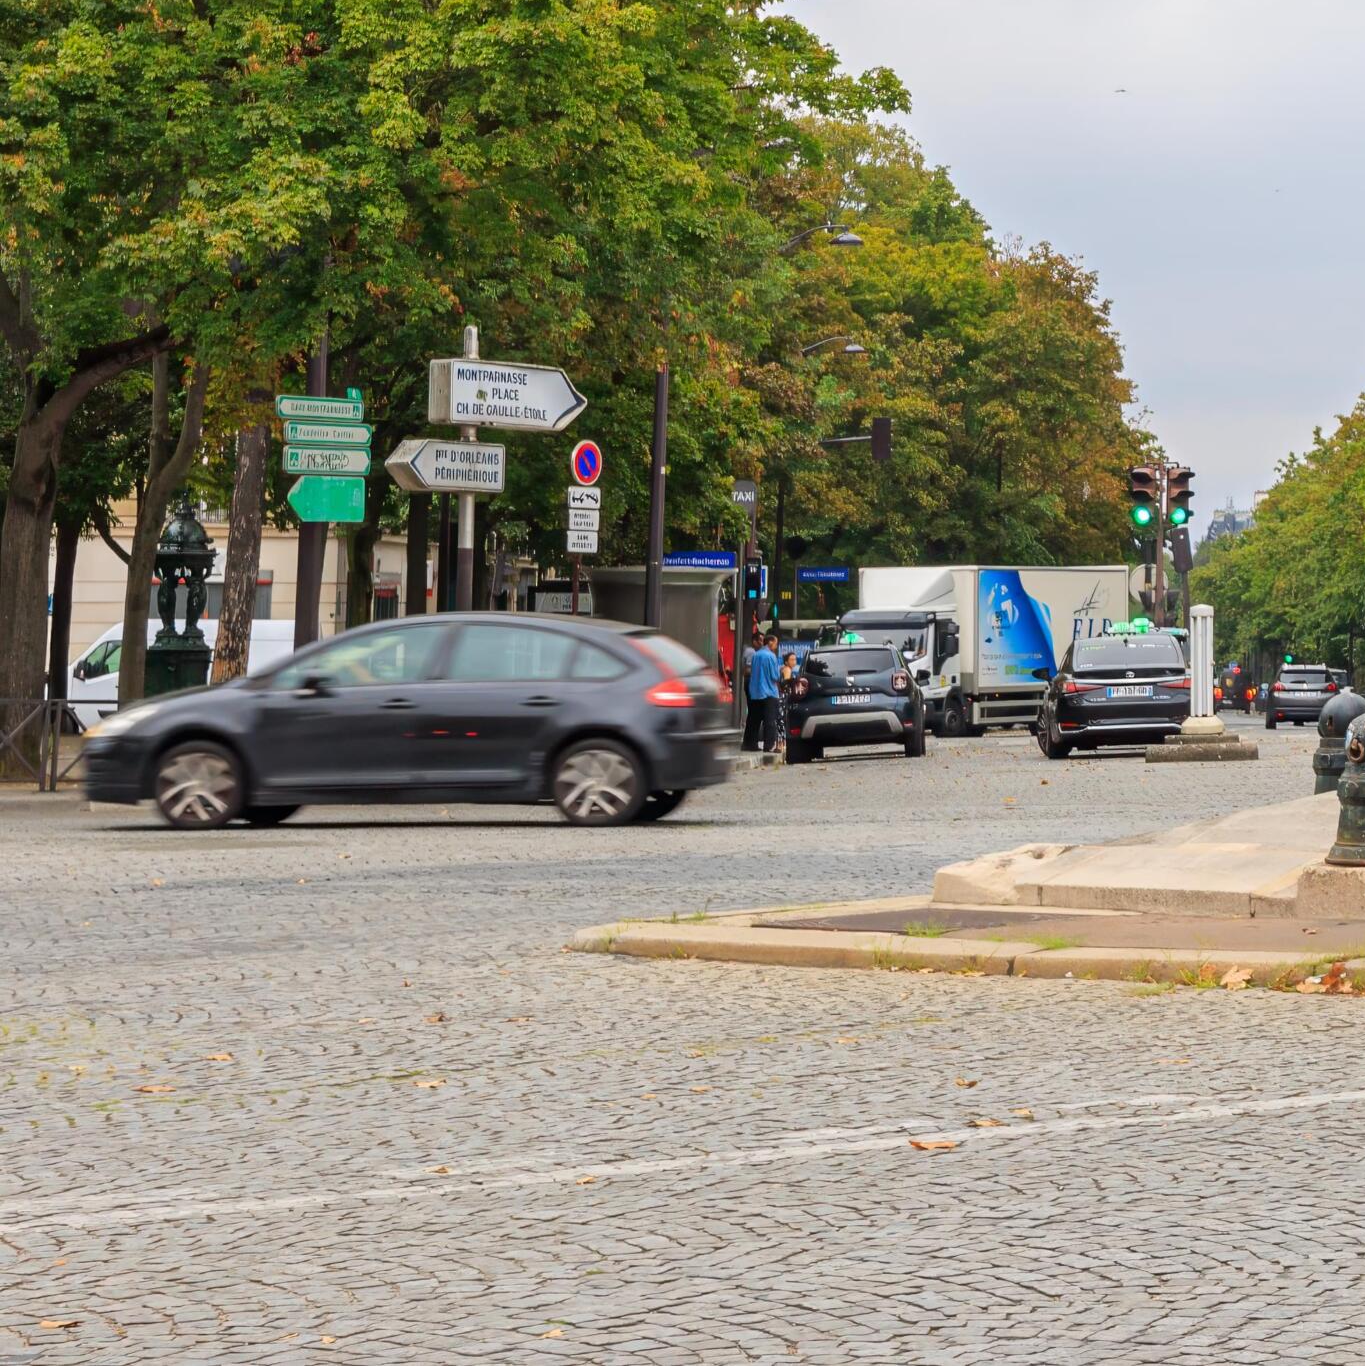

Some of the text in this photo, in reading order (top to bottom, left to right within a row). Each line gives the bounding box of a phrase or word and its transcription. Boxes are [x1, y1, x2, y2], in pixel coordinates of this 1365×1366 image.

[457, 367, 528, 386] MONTPARNASSE
[491, 388, 520, 401] PLACE
[456, 402, 469, 415] CH
[472, 403, 484, 416] DE
[731, 491, 755, 502] TAXI
